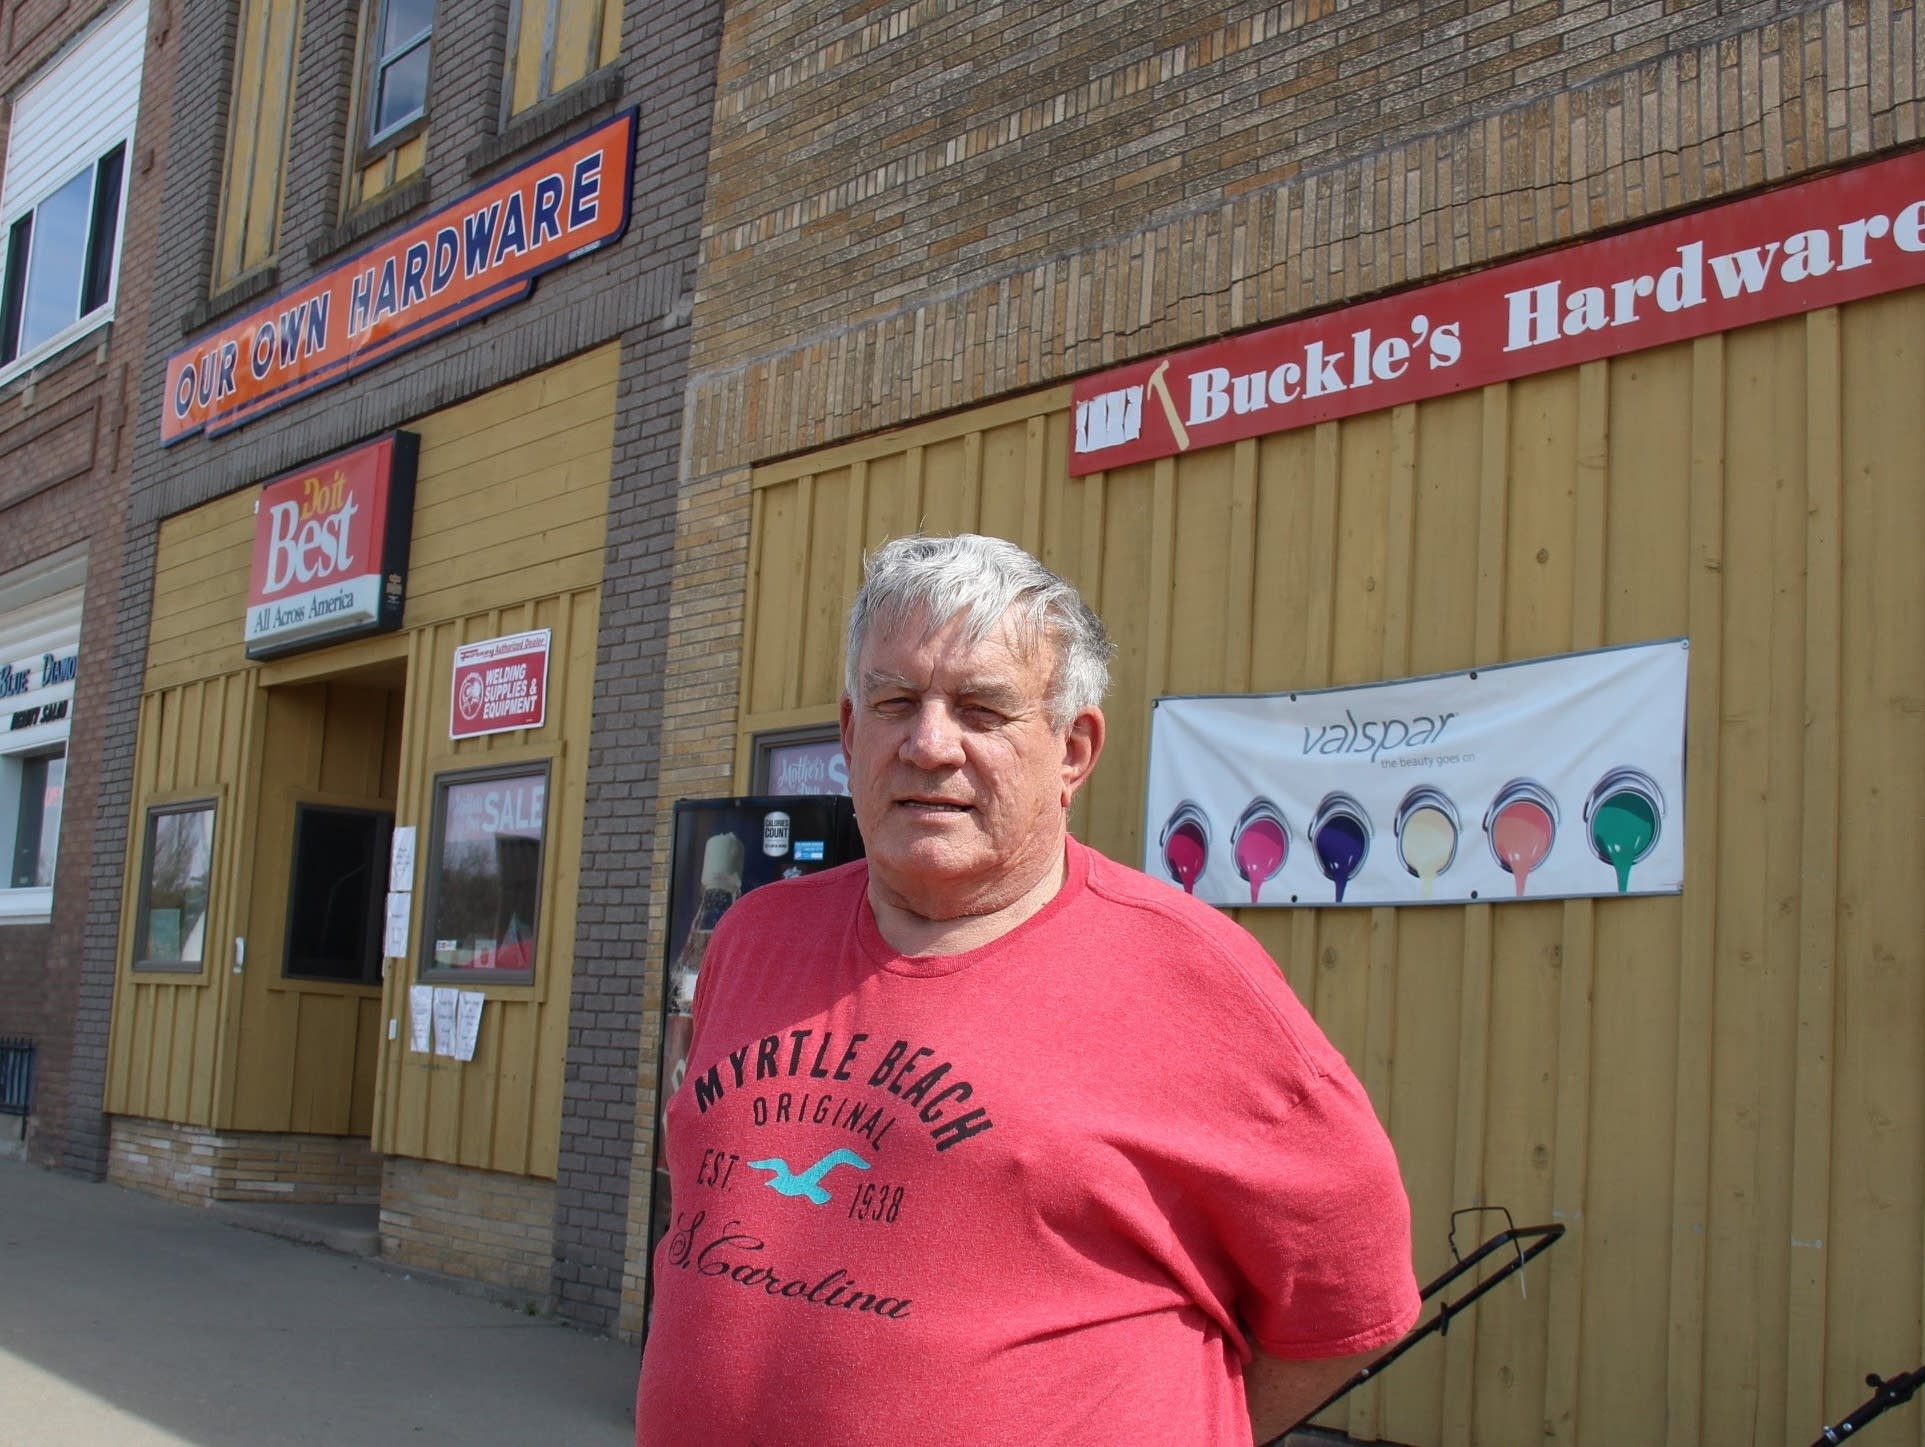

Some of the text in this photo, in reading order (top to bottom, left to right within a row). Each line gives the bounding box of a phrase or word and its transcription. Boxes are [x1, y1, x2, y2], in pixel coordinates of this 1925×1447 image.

[174, 149, 603, 420] OUR OWN HARDWARE
[1185, 199, 1925, 427] Buckle's Hardware
[262, 490, 359, 595] Best
[254, 606, 271, 633] All
[273, 603, 305, 629] Across
[308, 588, 355, 619] America
[484, 678, 538, 702] SUPPLIES &
[485, 663, 527, 686] WELDING
[483, 695, 538, 719] EQUIPMENT
[1302, 709, 1456, 763] valspar
[1381, 752, 1476, 769] the beauty goes on
[482, 784, 545, 833] SALE
[765, 827, 788, 839] COUNT
[695, 1030, 994, 1152] MYRTLE BEACH
[753, 1093, 896, 1151] ORIGINAL
[848, 1184, 904, 1223] 1938
[698, 1220, 913, 1319] Carolina
